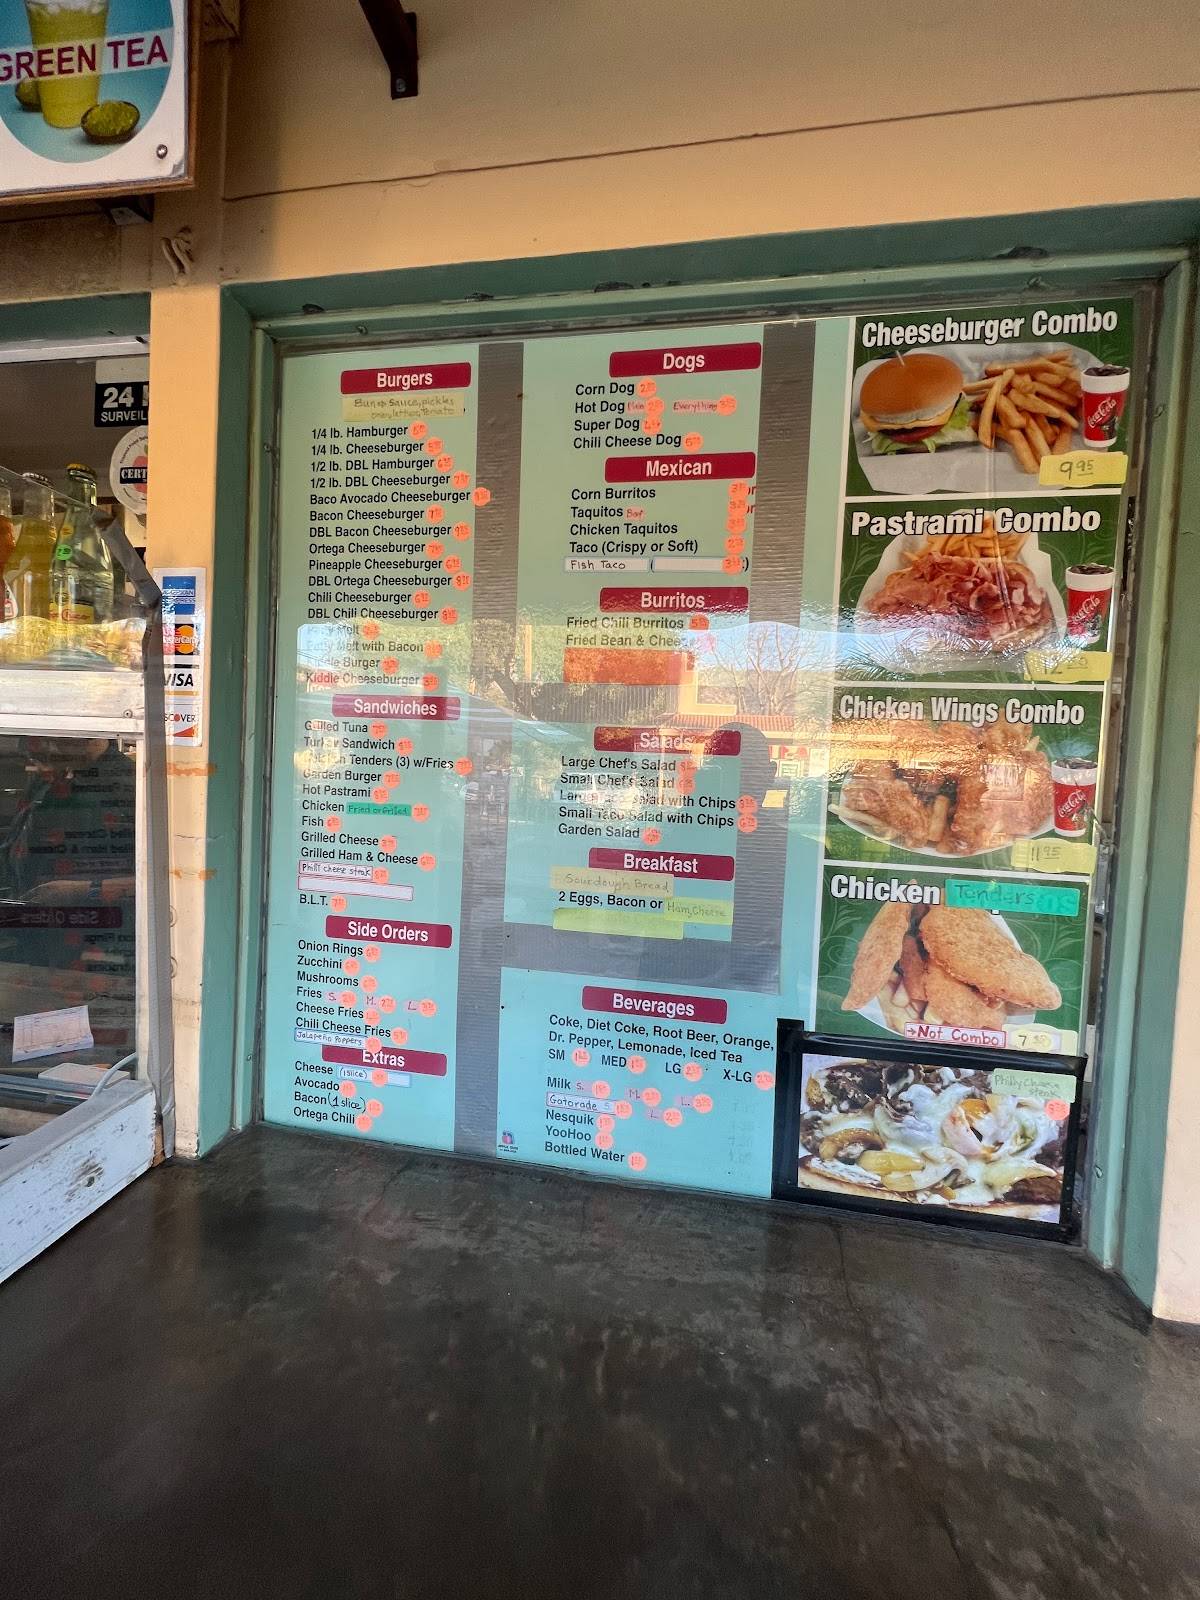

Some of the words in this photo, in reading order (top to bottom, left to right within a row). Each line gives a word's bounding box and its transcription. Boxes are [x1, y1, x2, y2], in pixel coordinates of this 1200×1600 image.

[0, 44, 96, 82] GREEN
[107, 36, 168, 69] TEA
[862, 317, 1024, 347] Cheeseburger
[1031, 307, 1118, 336] Combo
[663, 353, 705, 372] Dogs
[377, 373, 433, 390] Burgers
[576, 383, 605, 395] Corn
[610, 382, 635, 395] Dog
[103, 387, 134, 408] 24
[575, 402, 597, 413] Hot
[600, 401, 625, 413] Dog
[312, 428, 327, 439] 1/4
[347, 426, 408, 439] Hamburger
[574, 420, 610, 433] Super
[615, 418, 640, 431] Dog
[574, 437, 601, 449] Chili
[605, 435, 651, 448] Cheese
[656, 434, 681, 447] Dog
[312, 446, 327, 456] 1/4
[346, 442, 424, 455] Cheeseburger
[311, 462, 326, 472] 1/2
[346, 460, 368, 470] DBL
[372, 459, 434, 471] Hamburger
[646, 460, 712, 477] Mexican
[310, 478, 325, 489] 1/2
[345, 477, 368, 487] DBL
[372, 475, 450, 487] Cheeseburger
[340, 494, 387, 504] Avocado
[391, 491, 470, 504] Cheeseburger
[571, 488, 600, 500] Corn
[605, 488, 656, 499] Burritos
[310, 511, 343, 521] Bacon
[347, 509, 424, 522] Cheeseburger
[571, 507, 623, 520] Taquitos
[852, 508, 985, 536] Pastrami
[995, 506, 1101, 534] Combo
[310, 527, 331, 537] DBL
[335, 527, 369, 536] Bacon
[373, 525, 451, 538] Cheeseburger
[570, 524, 620, 535] Chicken
[624, 523, 678, 536] Taquitos
[309, 544, 345, 556] Ortega
[348, 543, 425, 555] Cheeseburger
[570, 542, 598, 552] Taco
[602, 541, 646, 554] (Crispy
[668, 540, 698, 553] Soft)
[309, 560, 361, 572] Pineapple
[365, 559, 442, 572] Cheeseburger
[571, 560, 594, 570] Fish
[601, 561, 625, 570] Taco
[309, 576, 330, 586] DBL
[334, 576, 370, 588] Ortega
[373, 575, 452, 588] Cheeseburger
[308, 592, 332, 602] Chili
[335, 592, 411, 604] Cheeseburger
[641, 592, 705, 609] Burritos
[308, 608, 329, 618] DBL
[333, 608, 357, 618] Chili
[361, 608, 438, 621] Cheeseburger
[566, 617, 598, 629] Fried
[601, 617, 630, 628] Chili
[634, 617, 684, 628] Burritos
[566, 635, 597, 646] Fried
[601, 635, 632, 646] Bean
[343, 657, 380, 670] Burger
[164, 674, 193, 686] VISA
[343, 673, 419, 686] Cheeseburger
[354, 699, 437, 715] Sandwiches
[839, 695, 923, 720] Chicken
[931, 696, 998, 726] Wings
[1006, 698, 1085, 725] Combo
[343, 722, 368, 732] Tuna
[342, 738, 394, 750] Sandwich
[640, 732, 692, 750] Salads
[349, 755, 392, 766] Tenders
[396, 756, 410, 769] (3)
[561, 756, 595, 769] Large
[599, 758, 637, 769] Chef's
[641, 759, 676, 771] Salad
[345, 771, 381, 783] Burger
[302, 784, 320, 794] Hot
[324, 785, 370, 797] Pastrami
[302, 800, 344, 811] Chicken
[699, 796, 736, 810] Chips
[302, 816, 323, 826] Fish
[559, 808, 592, 818] Small
[667, 812, 693, 824] with
[697, 814, 734, 826] Chips
[558, 824, 602, 837] Garden
[606, 826, 640, 838] Salad
[301, 832, 335, 843] Grilled
[339, 834, 378, 845] Cheese
[301, 848, 335, 859] Grilled
[338, 850, 362, 860] Ham
[377, 852, 418, 864] Cheese
[624, 853, 698, 873] Breakfast
[830, 874, 941, 905] Chicken
[300, 894, 328, 906] B.L.T.
[570, 892, 603, 906] Eggs,
[608, 895, 645, 908] Bacon
[348, 921, 377, 937] Side
[382, 924, 428, 941] Orders
[298, 940, 329, 952] Onion
[333, 944, 363, 957] Rings
[297, 955, 342, 969] Zucchini
[297, 971, 358, 987] Mushrooms
[296, 987, 322, 998] Fries
[296, 1002, 334, 1015] Cheese
[338, 1006, 364, 1019] Fries
[613, 993, 695, 1018] Beverages
[296, 1017, 319, 1029] Chili
[322, 1021, 361, 1033] Cheese
[365, 1025, 391, 1037] Fries
[549, 1015, 583, 1029] Coke,
[587, 1019, 610, 1031] Diet
[653, 1026, 683, 1039] Root
[687, 1030, 719, 1045] Beer,
[723, 1033, 774, 1050] Orange,
[917, 1025, 943, 1040] Not
[951, 1029, 999, 1046] Combo
[549, 1032, 565, 1043] Dr.
[569, 1034, 614, 1049] Pepper,
[618, 1040, 686, 1058] Lemonade,
[720, 1051, 742, 1063] Tea
[362, 1050, 405, 1067] Extras
[295, 1061, 333, 1074] Cheese
[548, 1050, 565, 1060] SM
[602, 1055, 627, 1068] MED
[665, 1063, 681, 1074] LG
[723, 1069, 752, 1083] X-LG
[295, 1077, 340, 1090] Avocado
[547, 1077, 571, 1090] Milk
[295, 1092, 327, 1105] Bacon
[294, 1107, 328, 1121] Ortega
[332, 1112, 355, 1124] Chili
[546, 1110, 594, 1126] Nesquik
[546, 1125, 591, 1141] YooHoo
[545, 1142, 587, 1157] Bottled
[592, 1149, 625, 1163] Water
